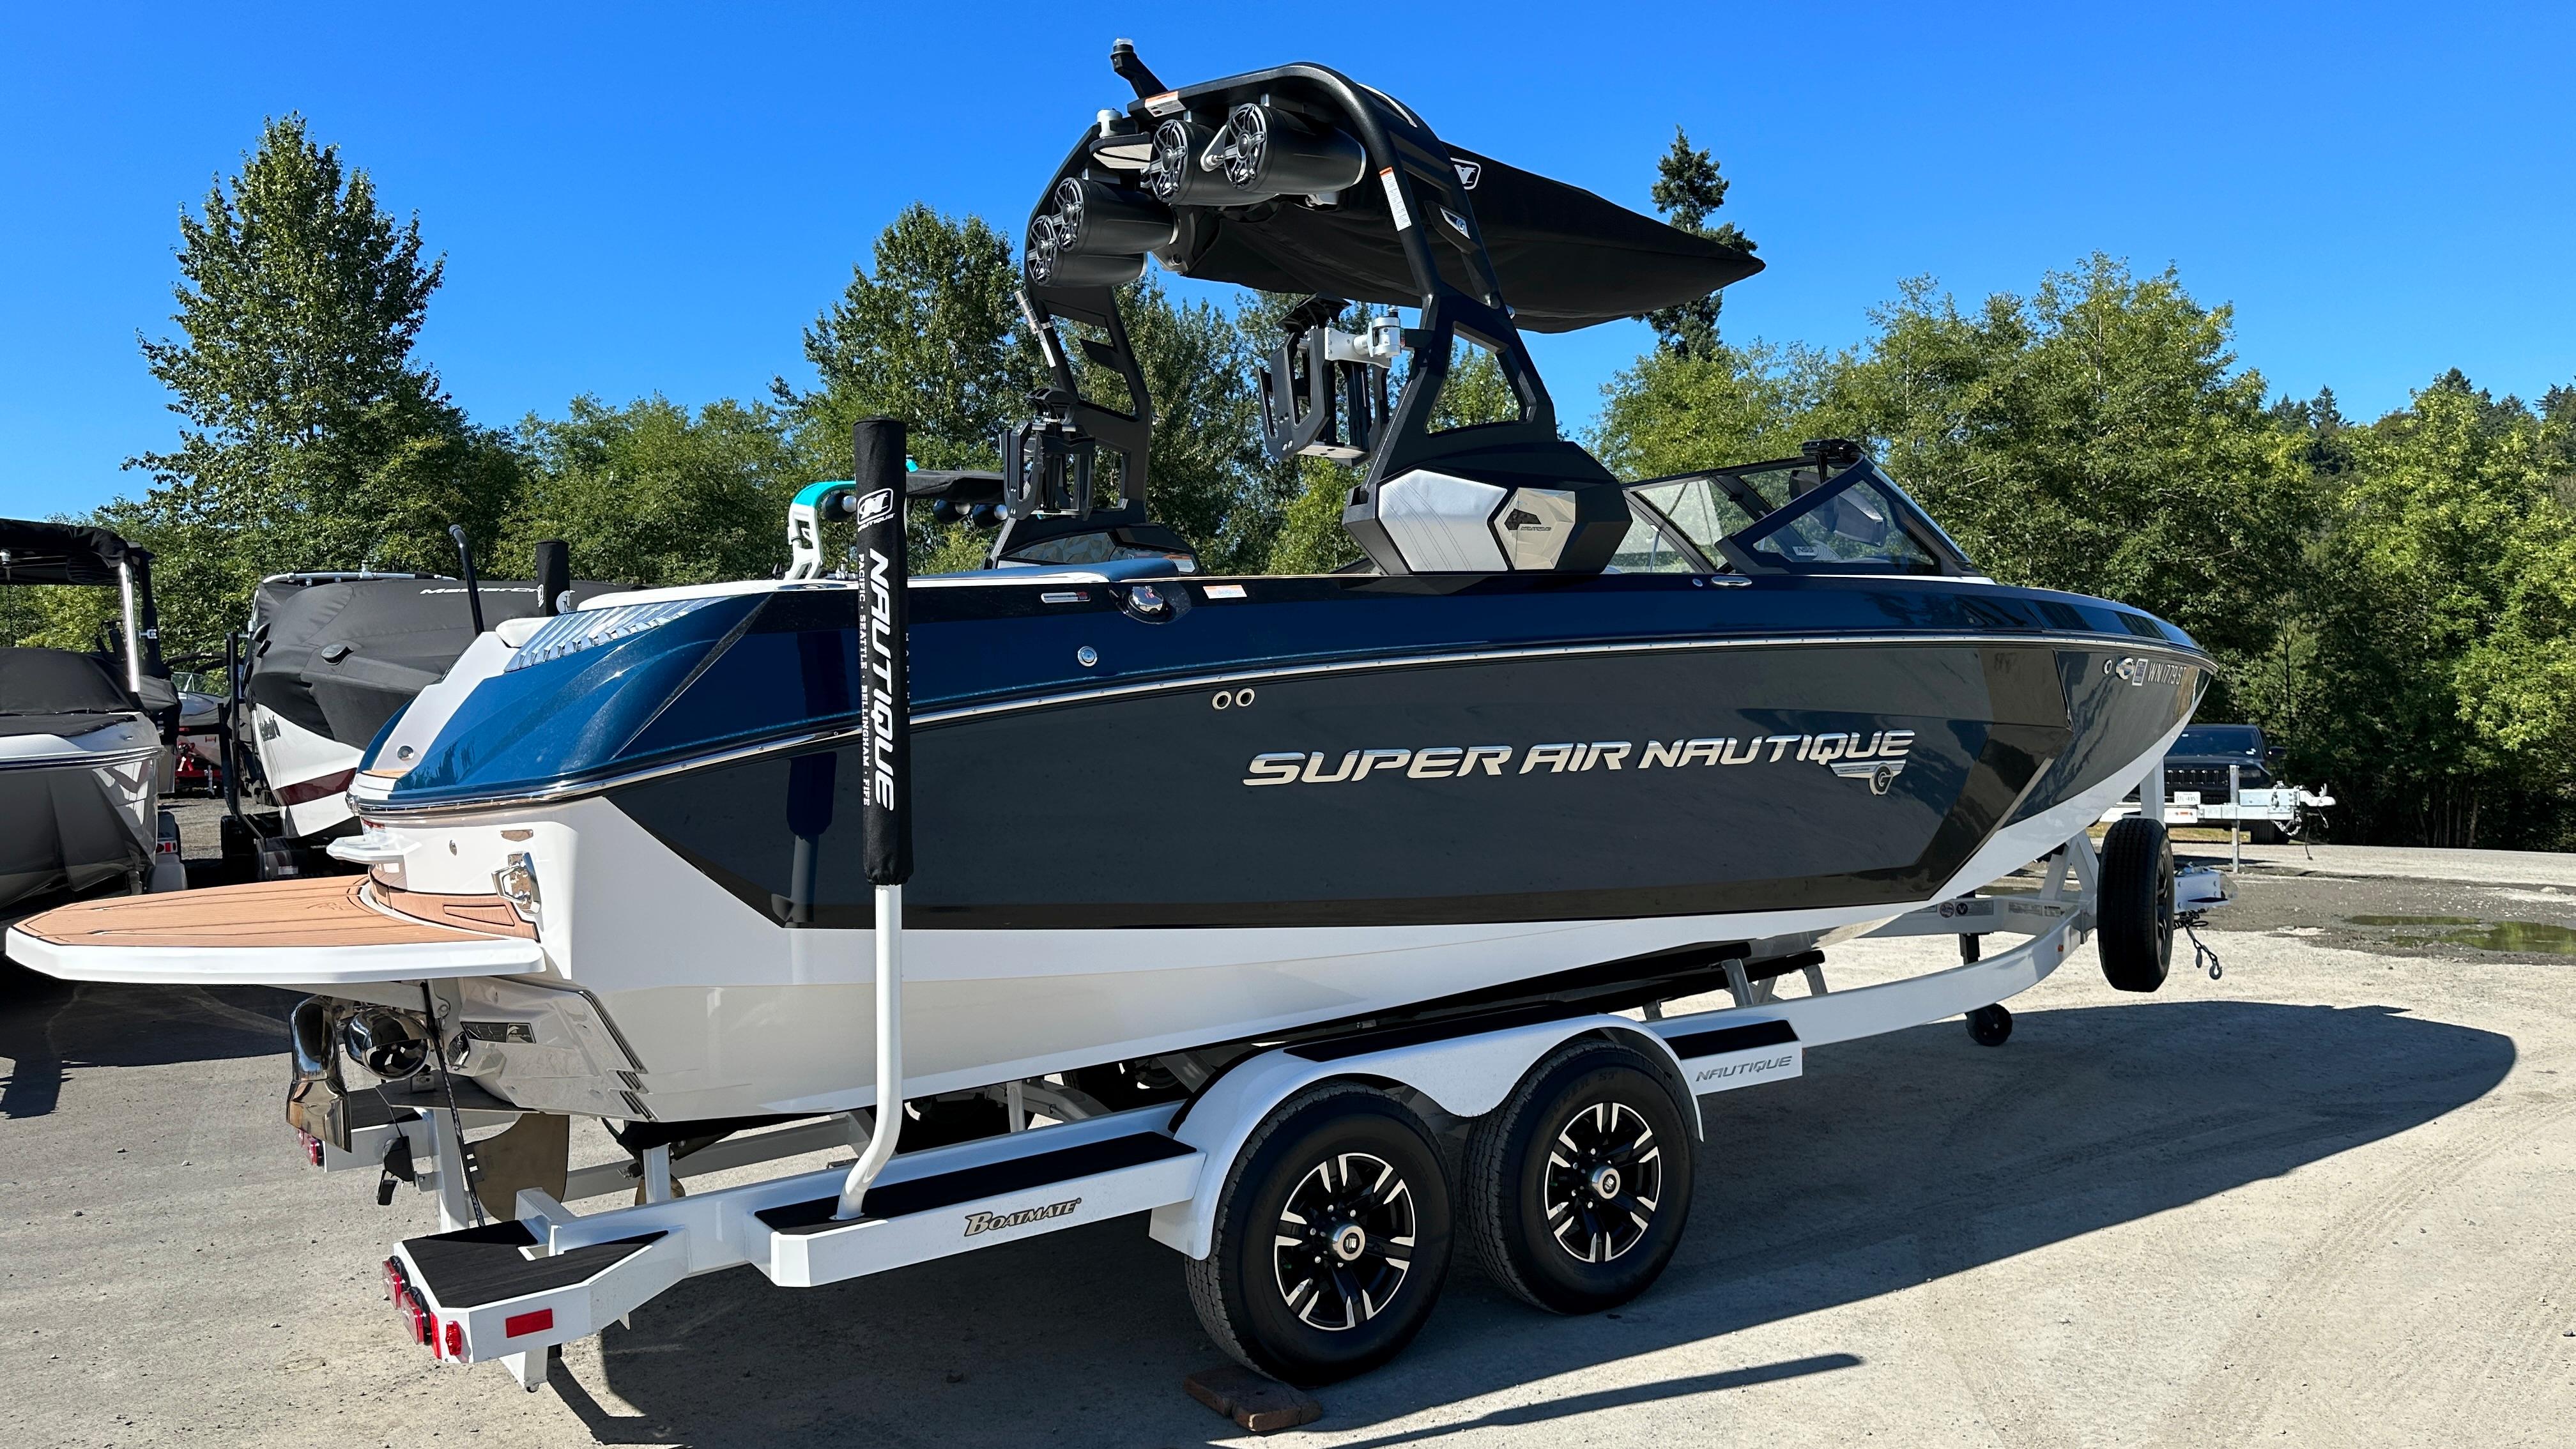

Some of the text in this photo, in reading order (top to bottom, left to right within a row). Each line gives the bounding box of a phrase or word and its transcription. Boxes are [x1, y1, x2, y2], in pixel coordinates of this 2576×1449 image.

[870, 548, 894, 811] NAUTIQUE
[862, 685, 870, 767] BELLINGHAM
[1243, 730, 1915, 786] SUPER AIR NAUTIQUE
[1696, 1055, 1793, 1082] NAUTIQUE
[964, 1201, 1078, 1237] BOATMATE
